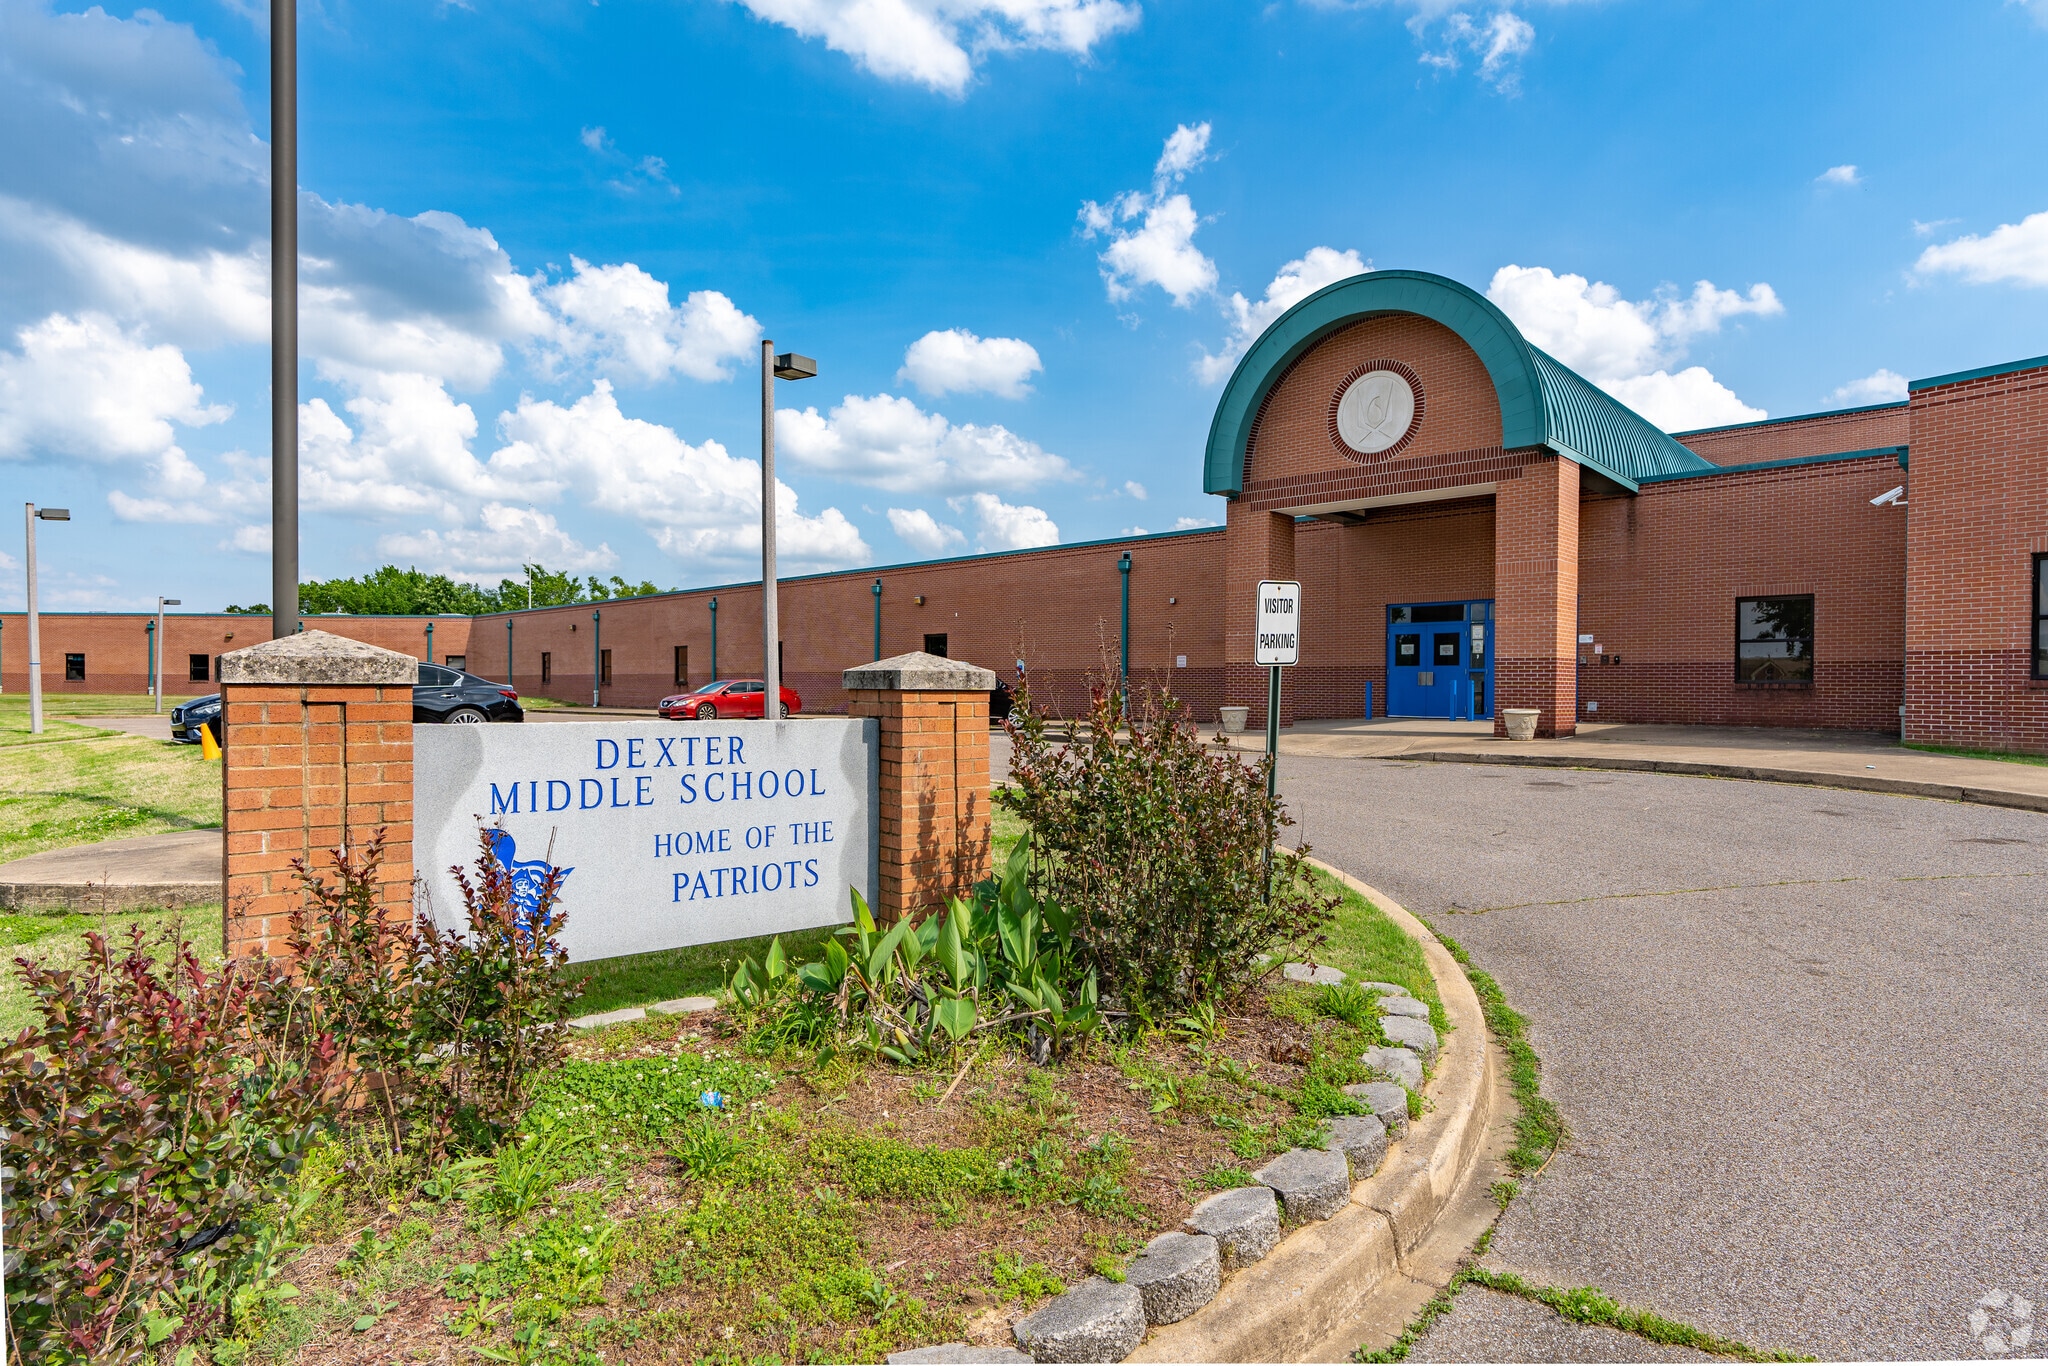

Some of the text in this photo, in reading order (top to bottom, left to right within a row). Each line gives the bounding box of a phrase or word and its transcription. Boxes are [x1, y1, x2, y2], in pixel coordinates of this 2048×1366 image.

[1264, 598, 1294, 614] VISITOR
[1259, 633, 1295, 649] PARKING
[595, 736, 746, 770] DEXTER
[489, 768, 827, 815] MIDDLE SCHOOL
[654, 820, 834, 858] HOME OF THE
[672, 858, 819, 902] PATRIOTS
